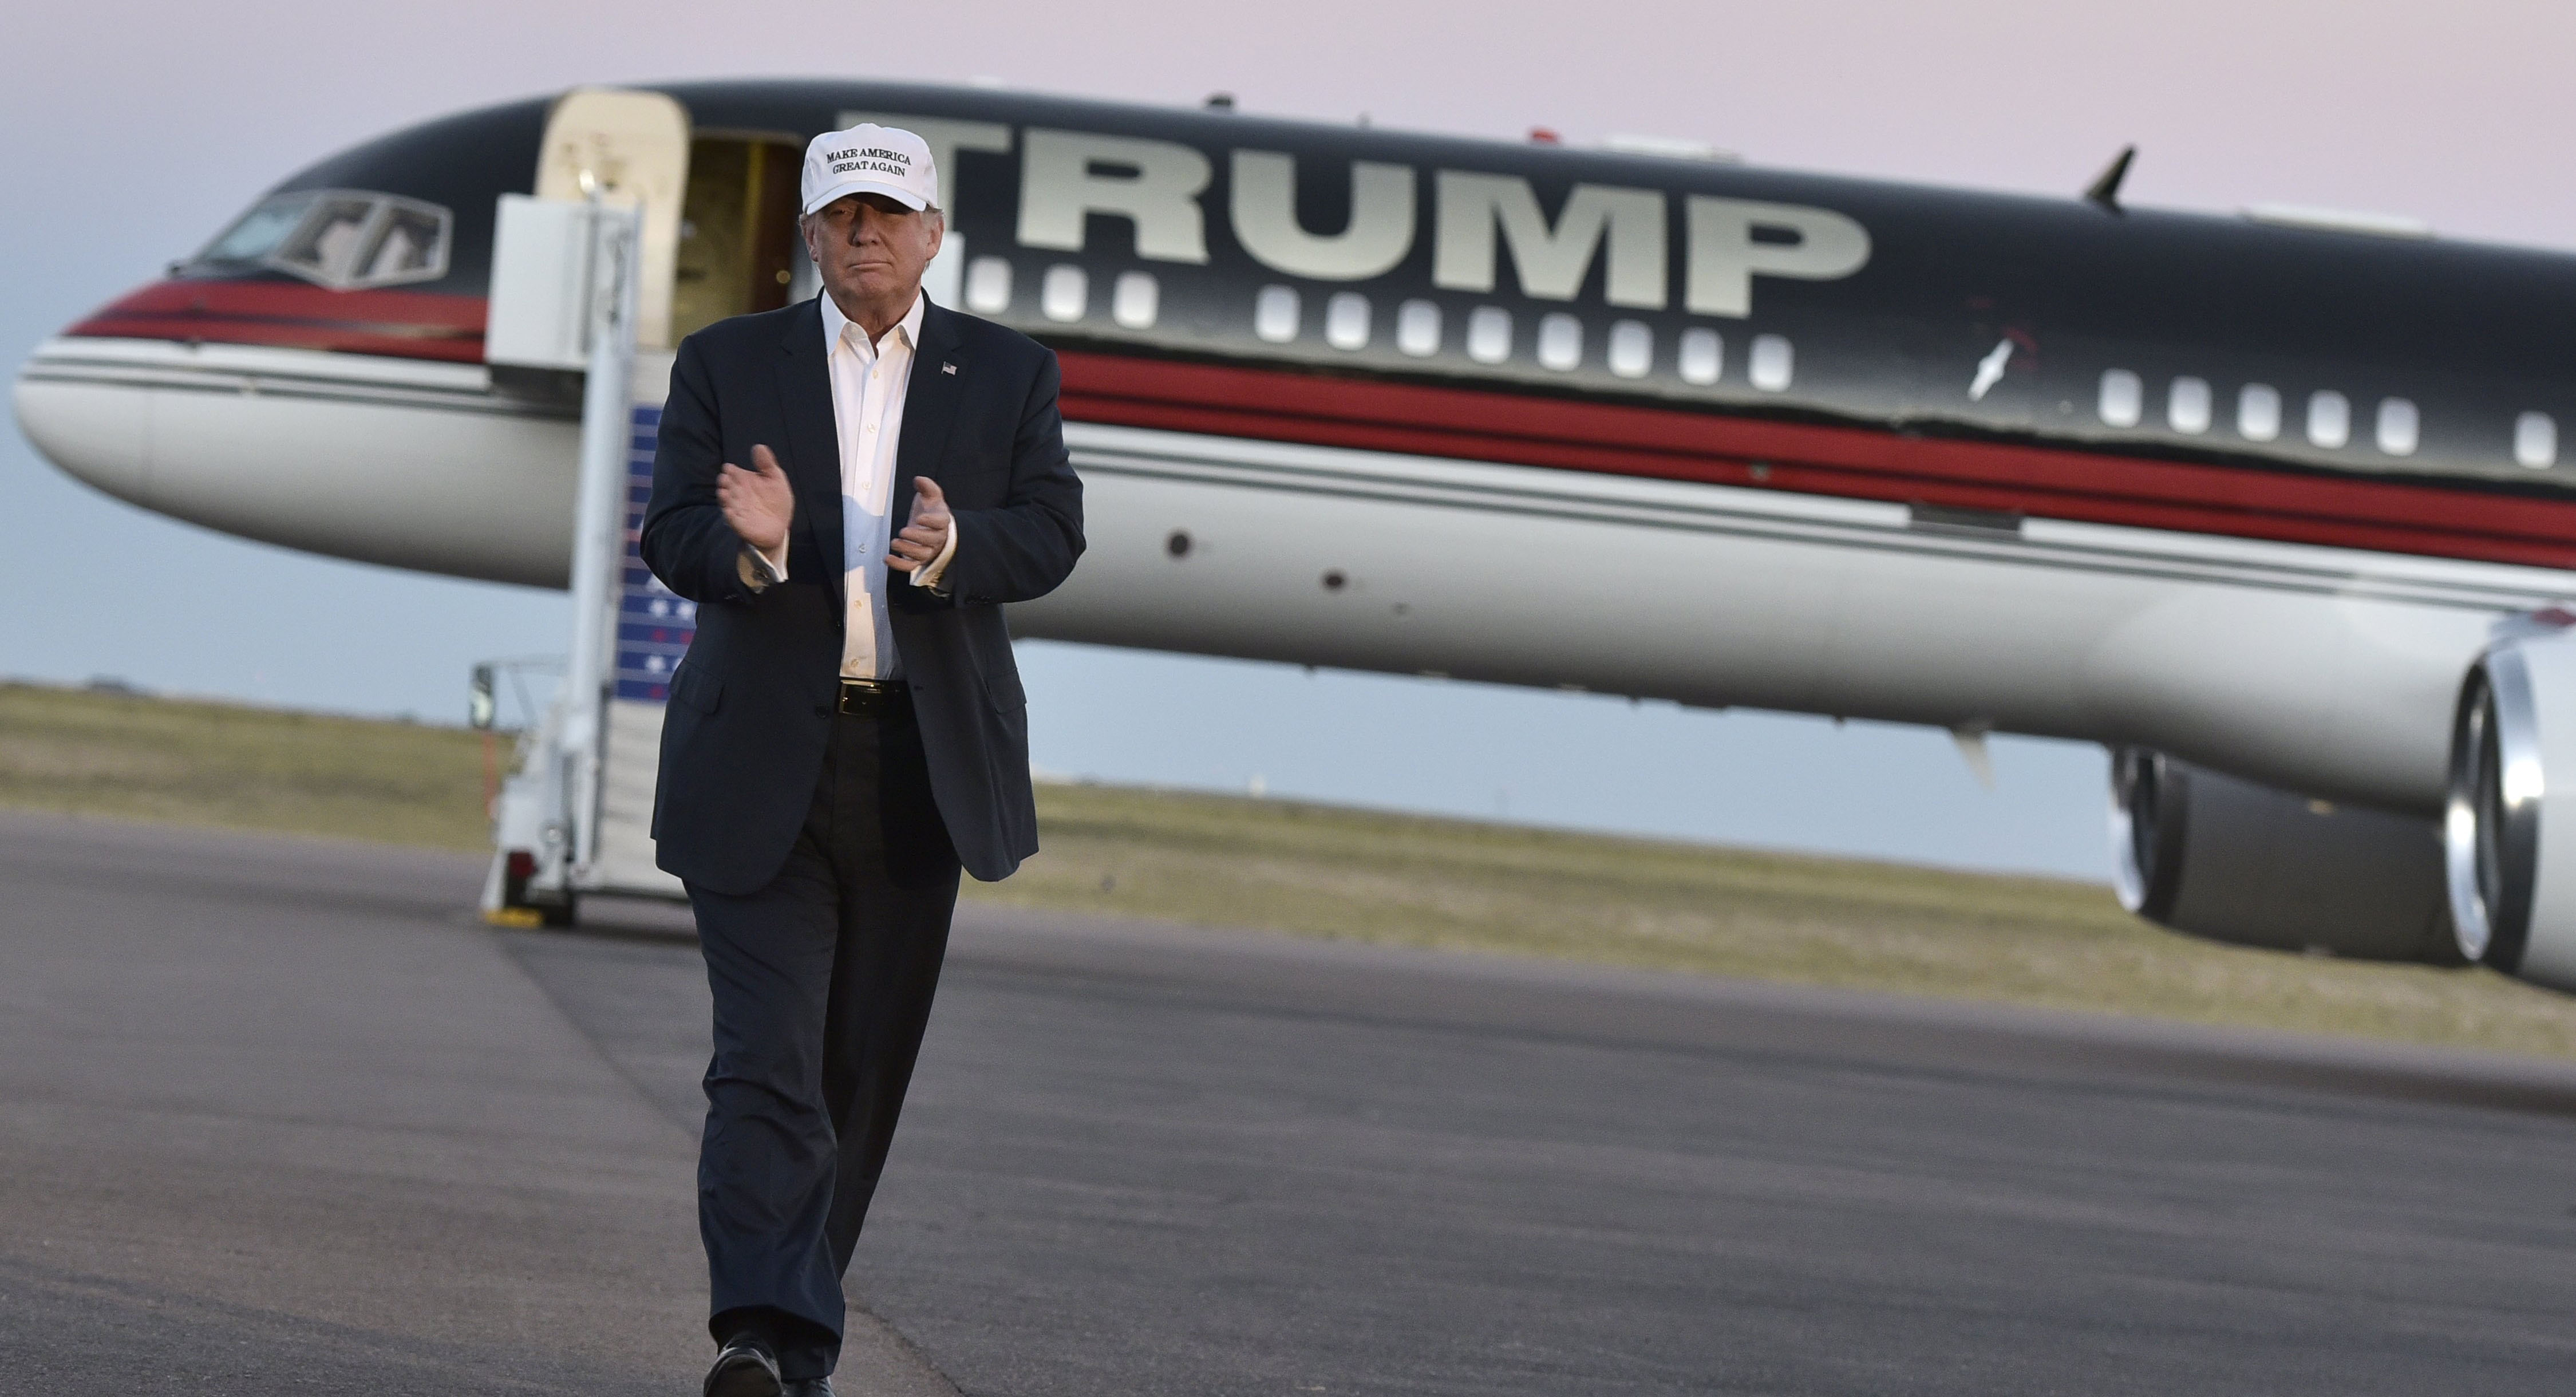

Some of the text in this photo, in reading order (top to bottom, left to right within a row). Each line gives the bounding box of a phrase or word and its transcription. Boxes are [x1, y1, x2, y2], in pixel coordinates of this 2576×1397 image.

[827, 148, 911, 165] MAKE AMERICA
[833, 161, 905, 177] GREAT AGAIN
[836, 111, 1872, 319] TRUMP
